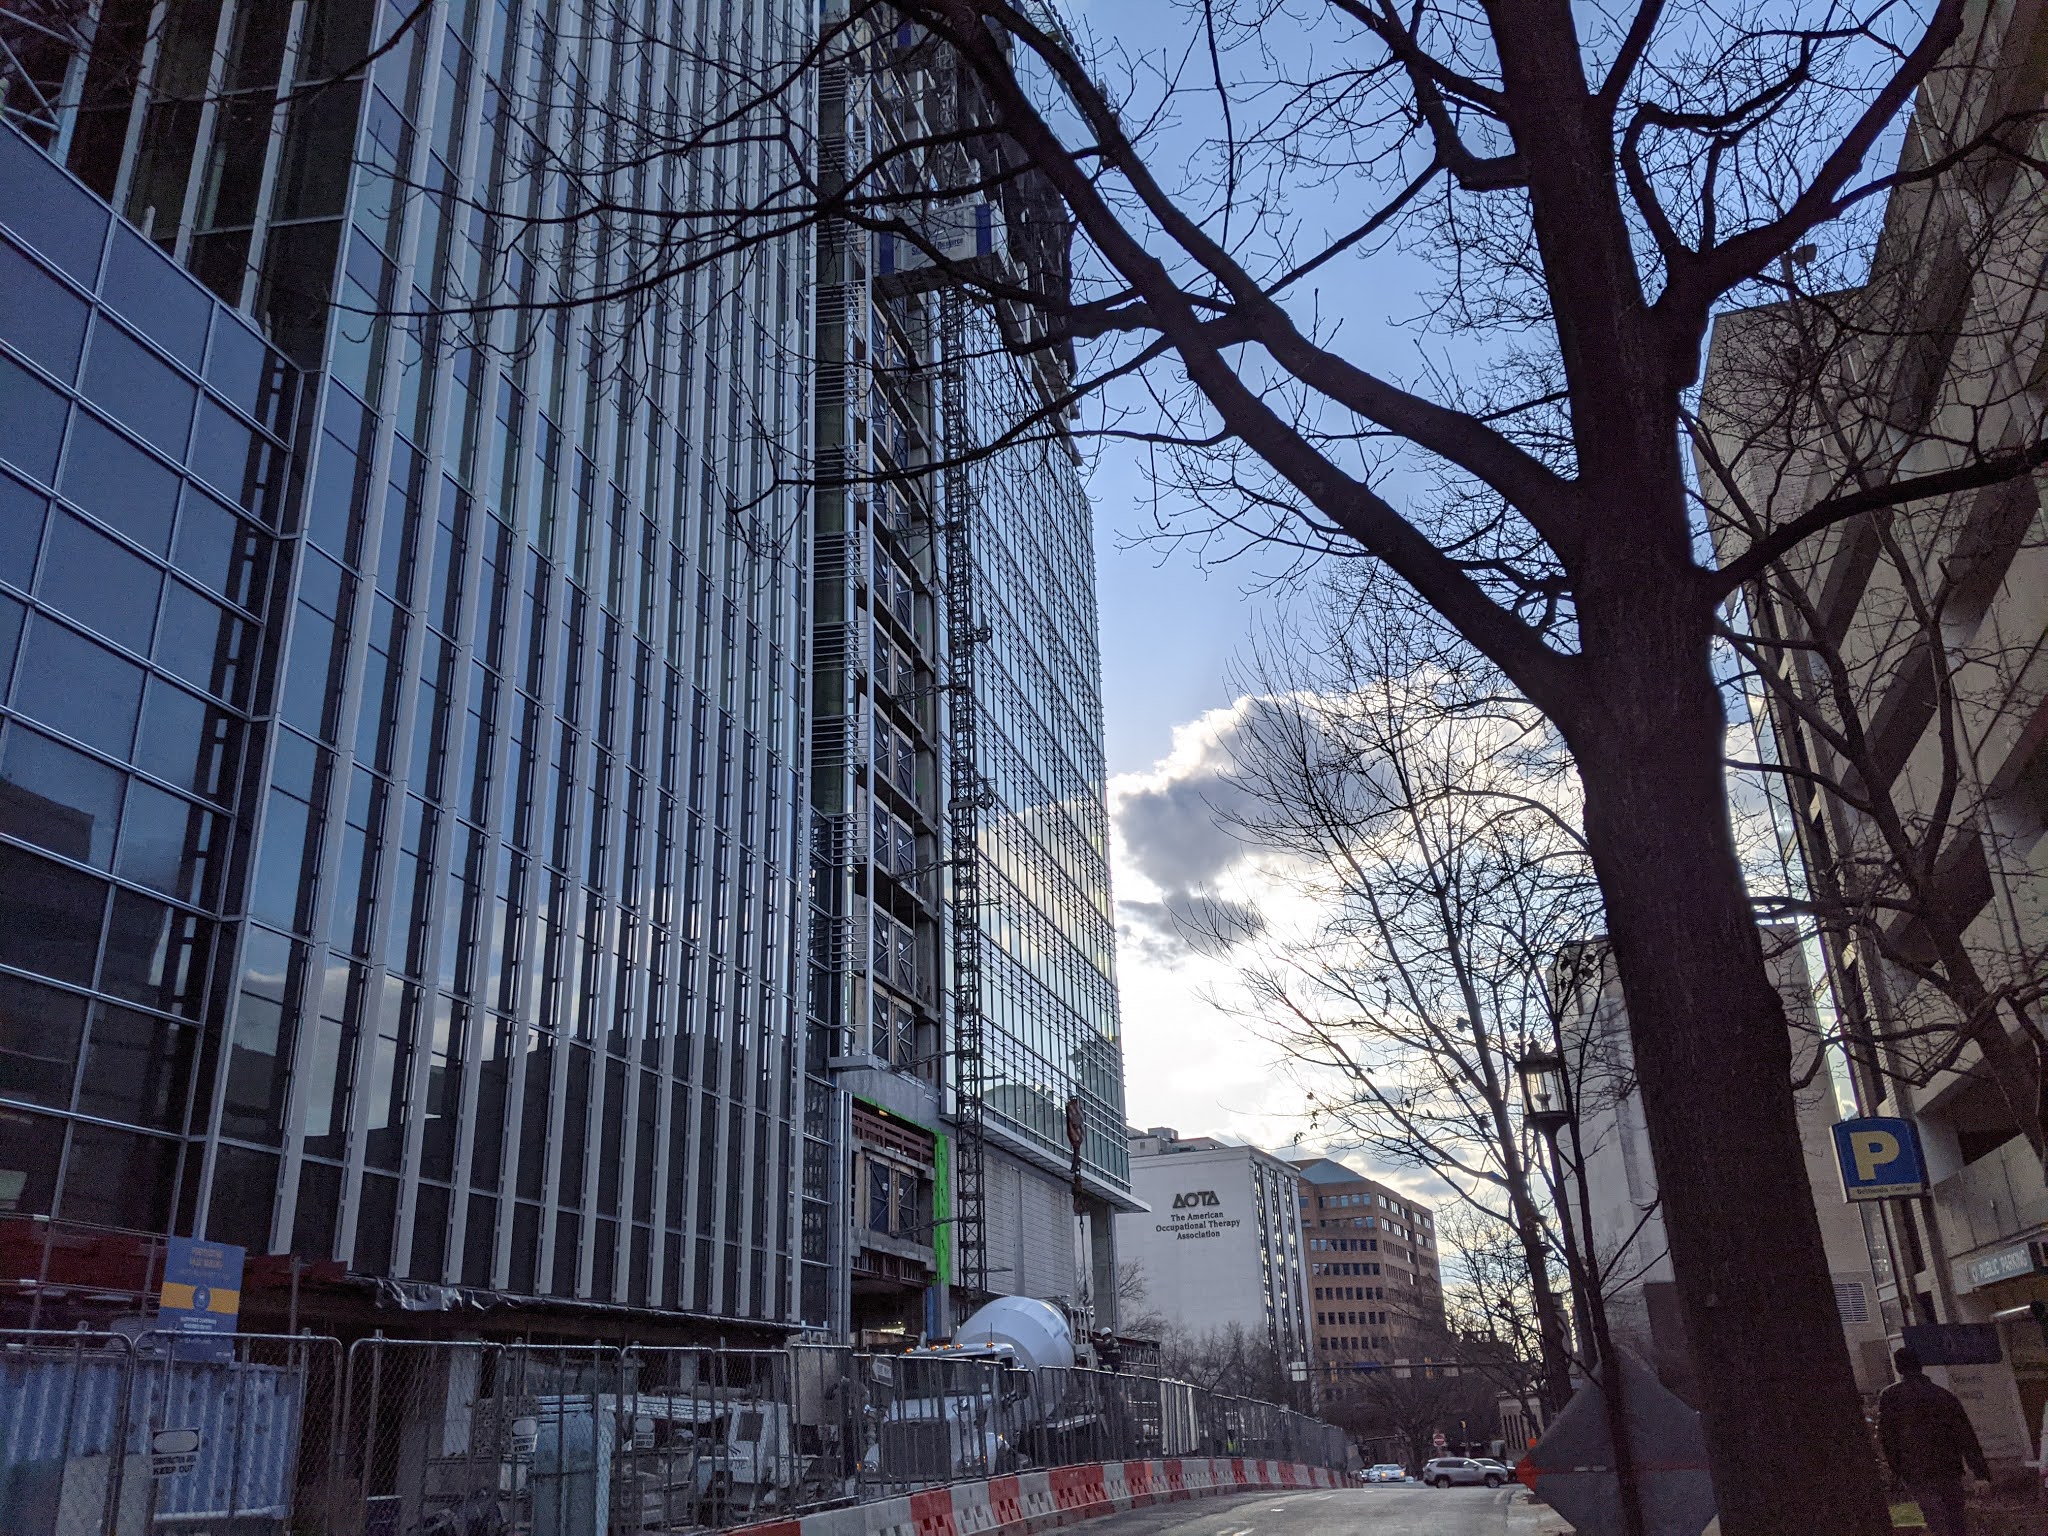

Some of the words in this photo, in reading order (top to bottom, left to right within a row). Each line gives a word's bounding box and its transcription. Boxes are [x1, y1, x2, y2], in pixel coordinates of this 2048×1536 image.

[1849, 1130, 1900, 1181] P
[1173, 1191, 1220, 1208] AOTA
[1170, 1214, 1185, 1222] The
[1187, 1212, 1224, 1220] American
[1156, 1221, 1206, 1232] Occupational
[1208, 1220, 1240, 1228] Therapy
[1177, 1231, 1220, 1240] Association
[153, 1466, 176, 1475] KEEP
[178, 1464, 194, 1474] OUT
